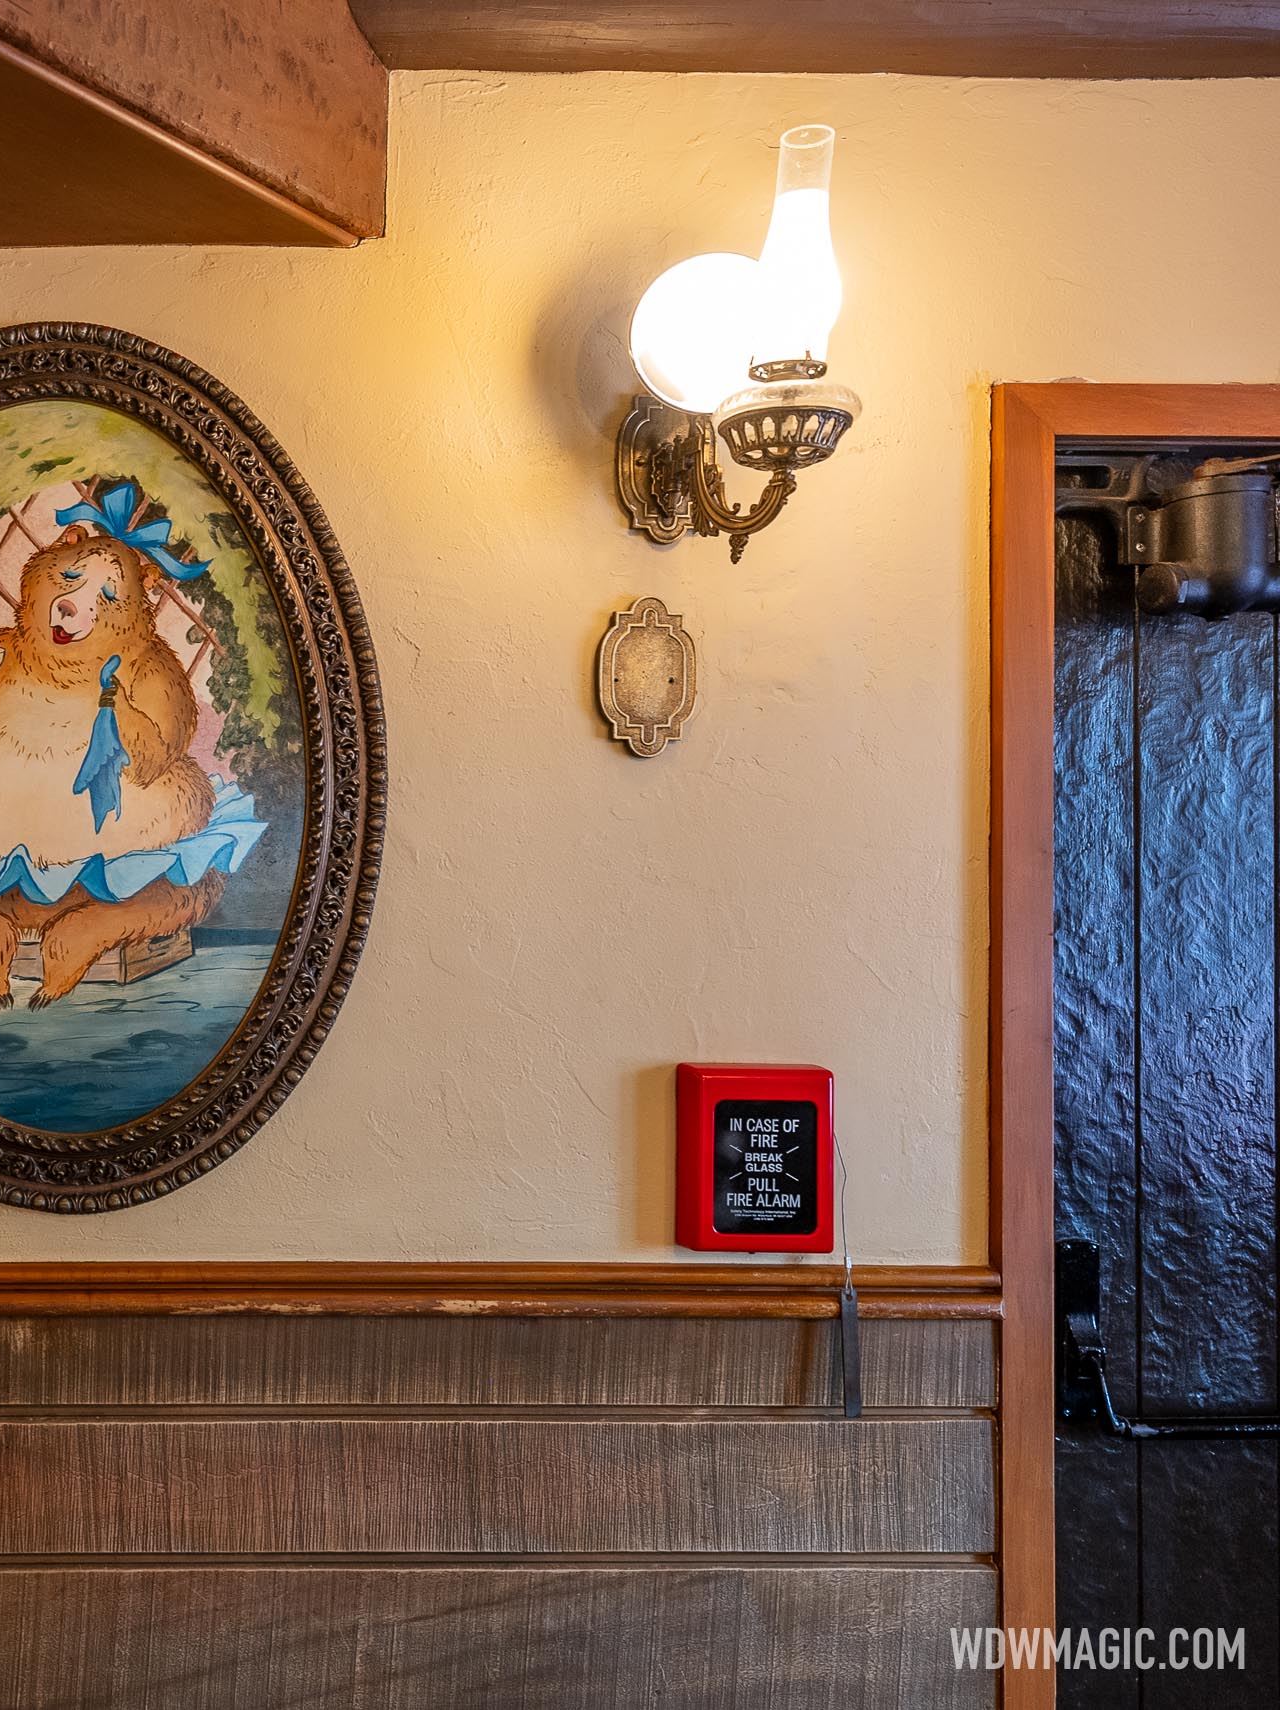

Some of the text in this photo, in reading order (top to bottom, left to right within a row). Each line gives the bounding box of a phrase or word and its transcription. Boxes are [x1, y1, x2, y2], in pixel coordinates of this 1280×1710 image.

[729, 1118, 800, 1133] IN CASE OF
[750, 1134, 779, 1148] FIRE
[744, 1152, 784, 1163] BREAK
[745, 1163, 783, 1173] GLASS
[748, 1178, 780, 1192] PULL
[726, 1193, 801, 1208] FIRE ALARM
